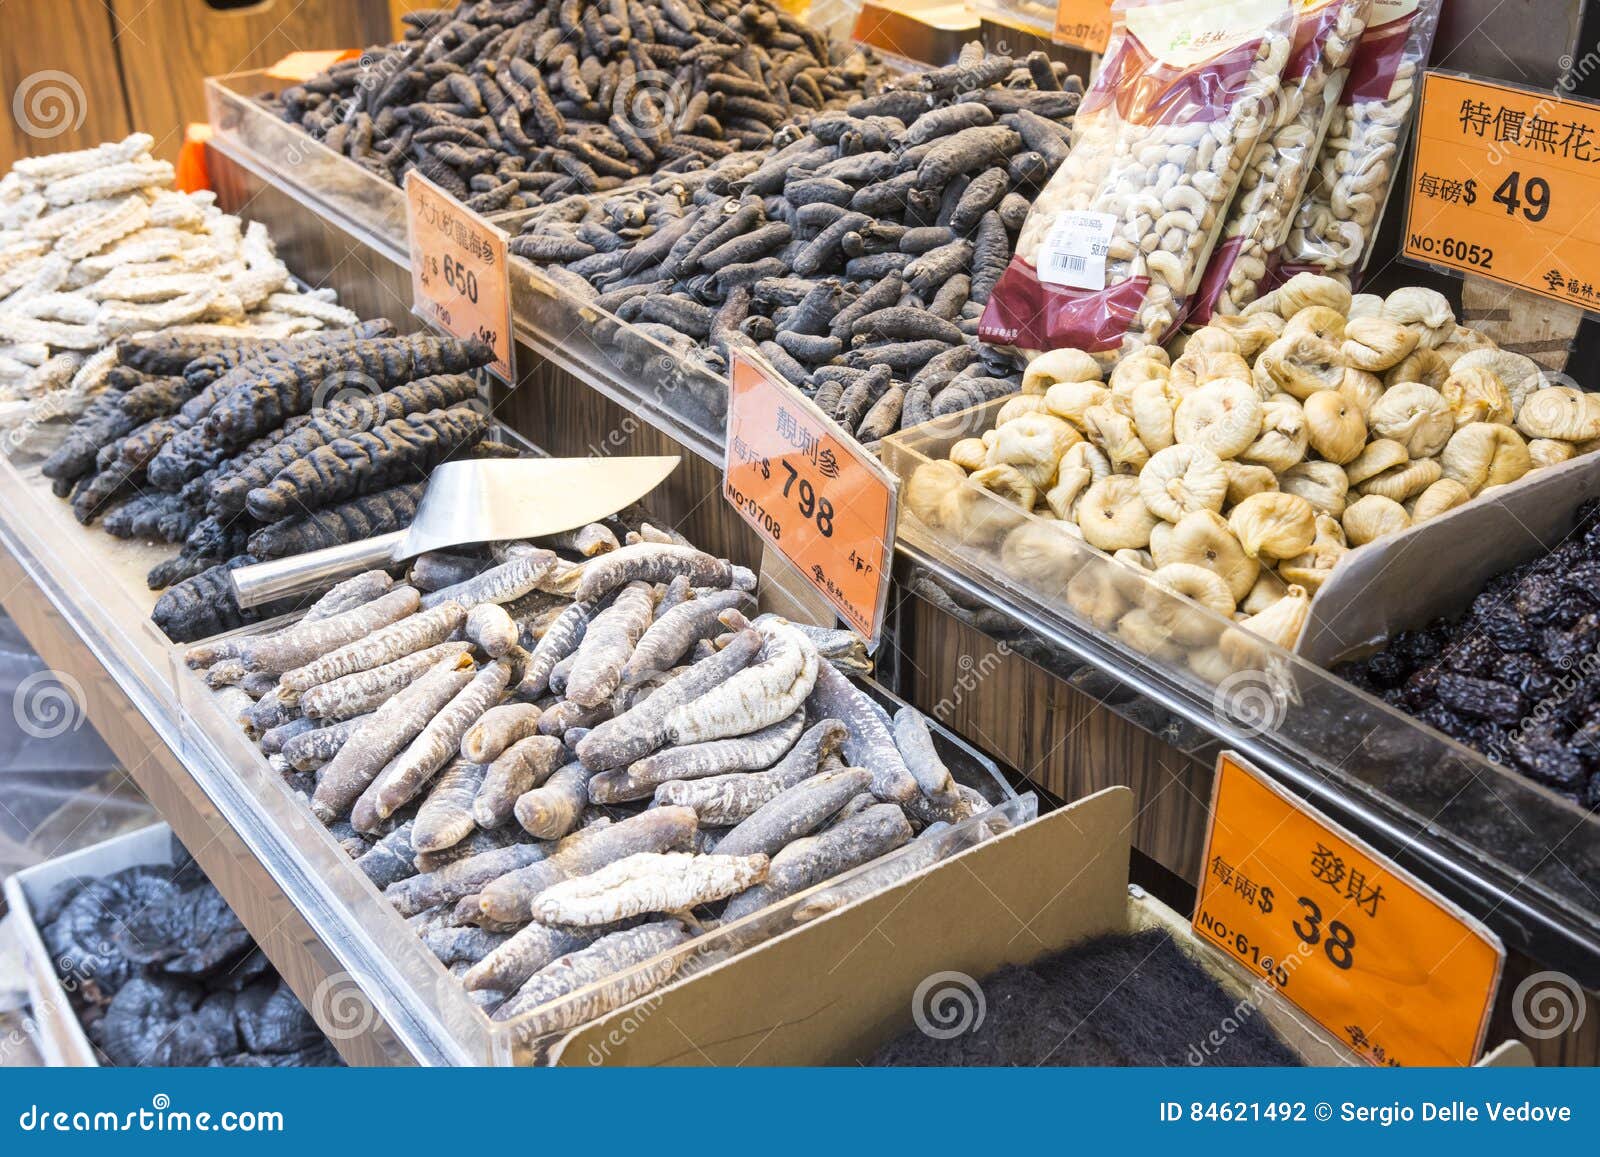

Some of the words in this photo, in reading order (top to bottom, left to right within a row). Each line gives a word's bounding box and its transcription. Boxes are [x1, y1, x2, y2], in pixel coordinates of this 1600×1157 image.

[1459, 99, 1600, 162] 特價無花
[1493, 171, 1550, 222] 49
[444, 254, 478, 304] 650
[1410, 234, 1493, 269] NO:6052
[728, 483, 781, 540] NO:0708
[782, 459, 834, 538] 798
[1311, 843, 1386, 918] 發財
[1292, 896, 1356, 970] 38
